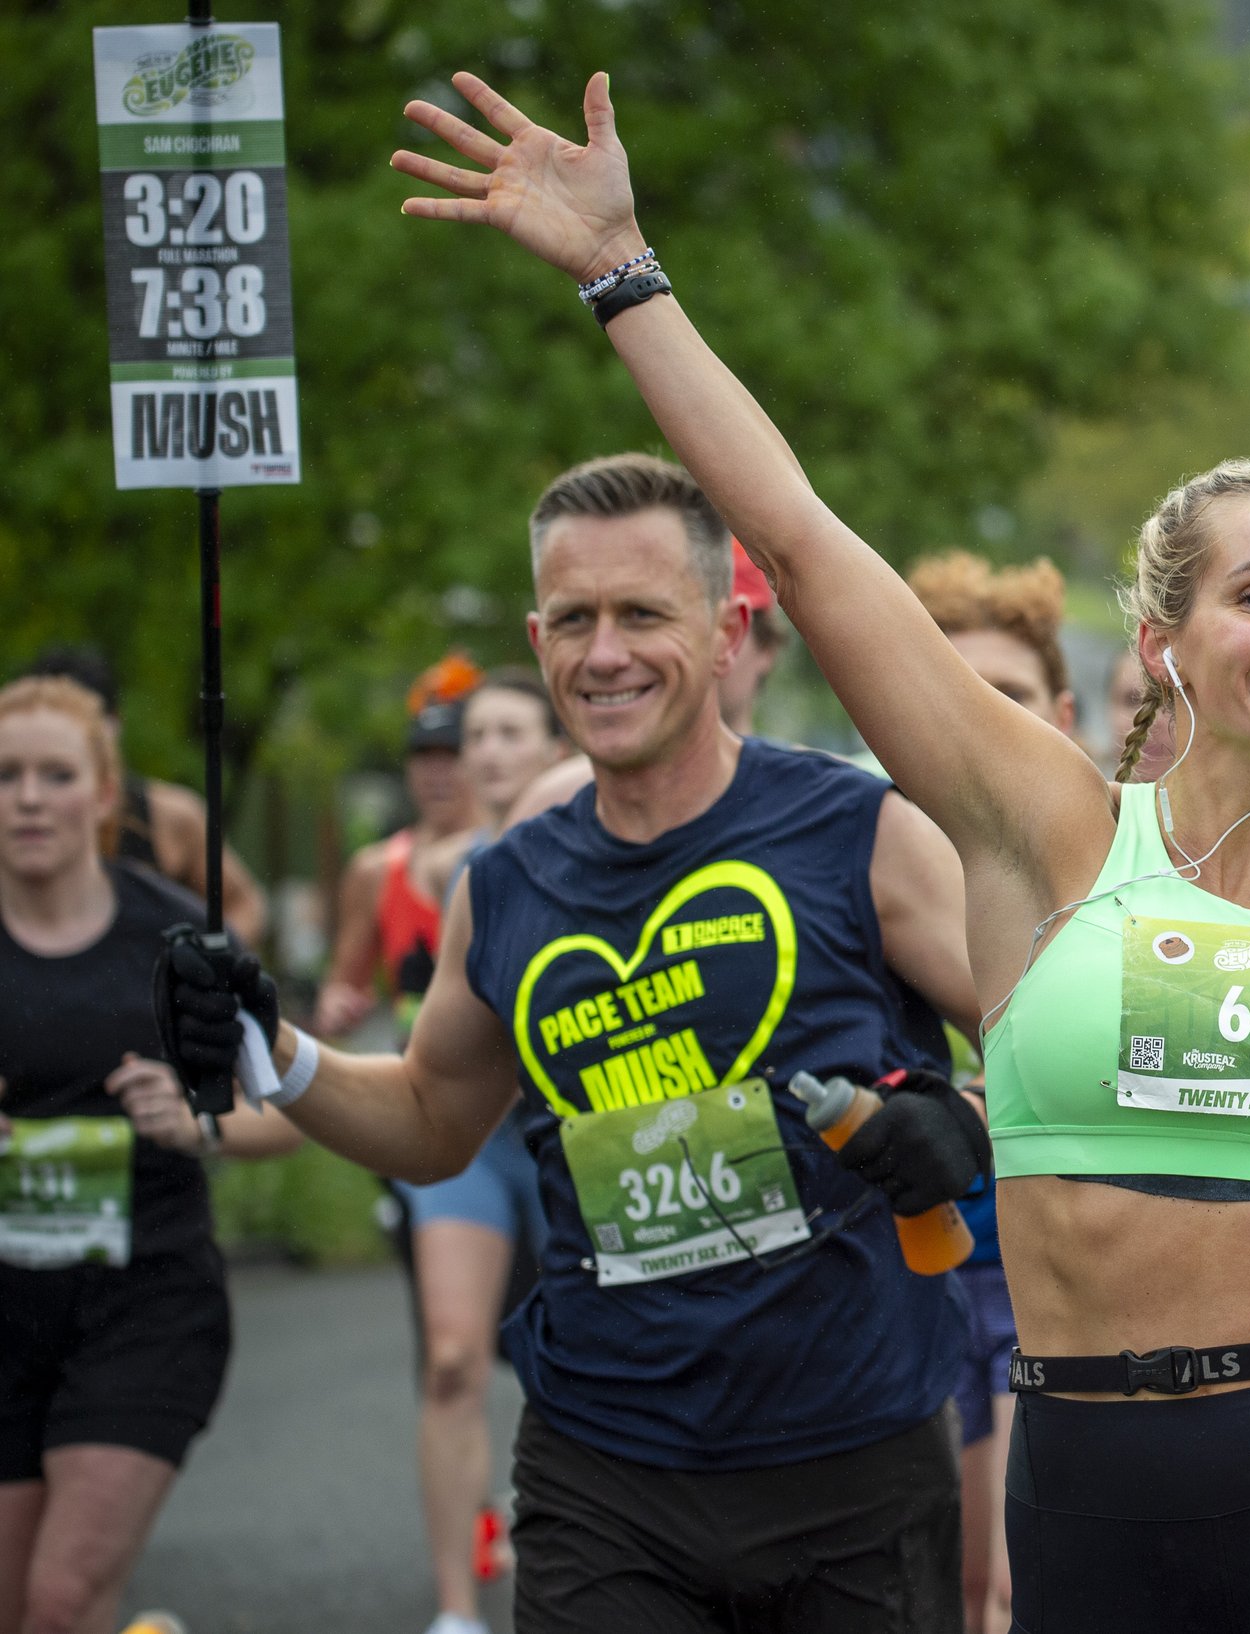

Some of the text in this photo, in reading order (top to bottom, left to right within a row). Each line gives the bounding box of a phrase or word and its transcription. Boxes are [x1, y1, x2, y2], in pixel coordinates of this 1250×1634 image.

[145, 42, 235, 103] EUGENE
[144, 136, 171, 153] SAM
[123, 171, 266, 246] 3:20
[131, 264, 266, 339] 7:38
[131, 389, 283, 461] MUSH
[694, 912, 764, 940] ONPACE
[538, 959, 705, 1056] PACE TEAM
[579, 1028, 718, 1113] MUSH
[1183, 1051, 1236, 1068] KRUSTEAZ
[1193, 1062, 1225, 1073] Company
[1178, 1088, 1249, 1109] TWENTY
[619, 1151, 741, 1221] 3266
[639, 1249, 693, 1274] TWENTY
[1010, 1360, 1045, 1387] ALS
[1178, 1351, 1240, 1383] ALS
